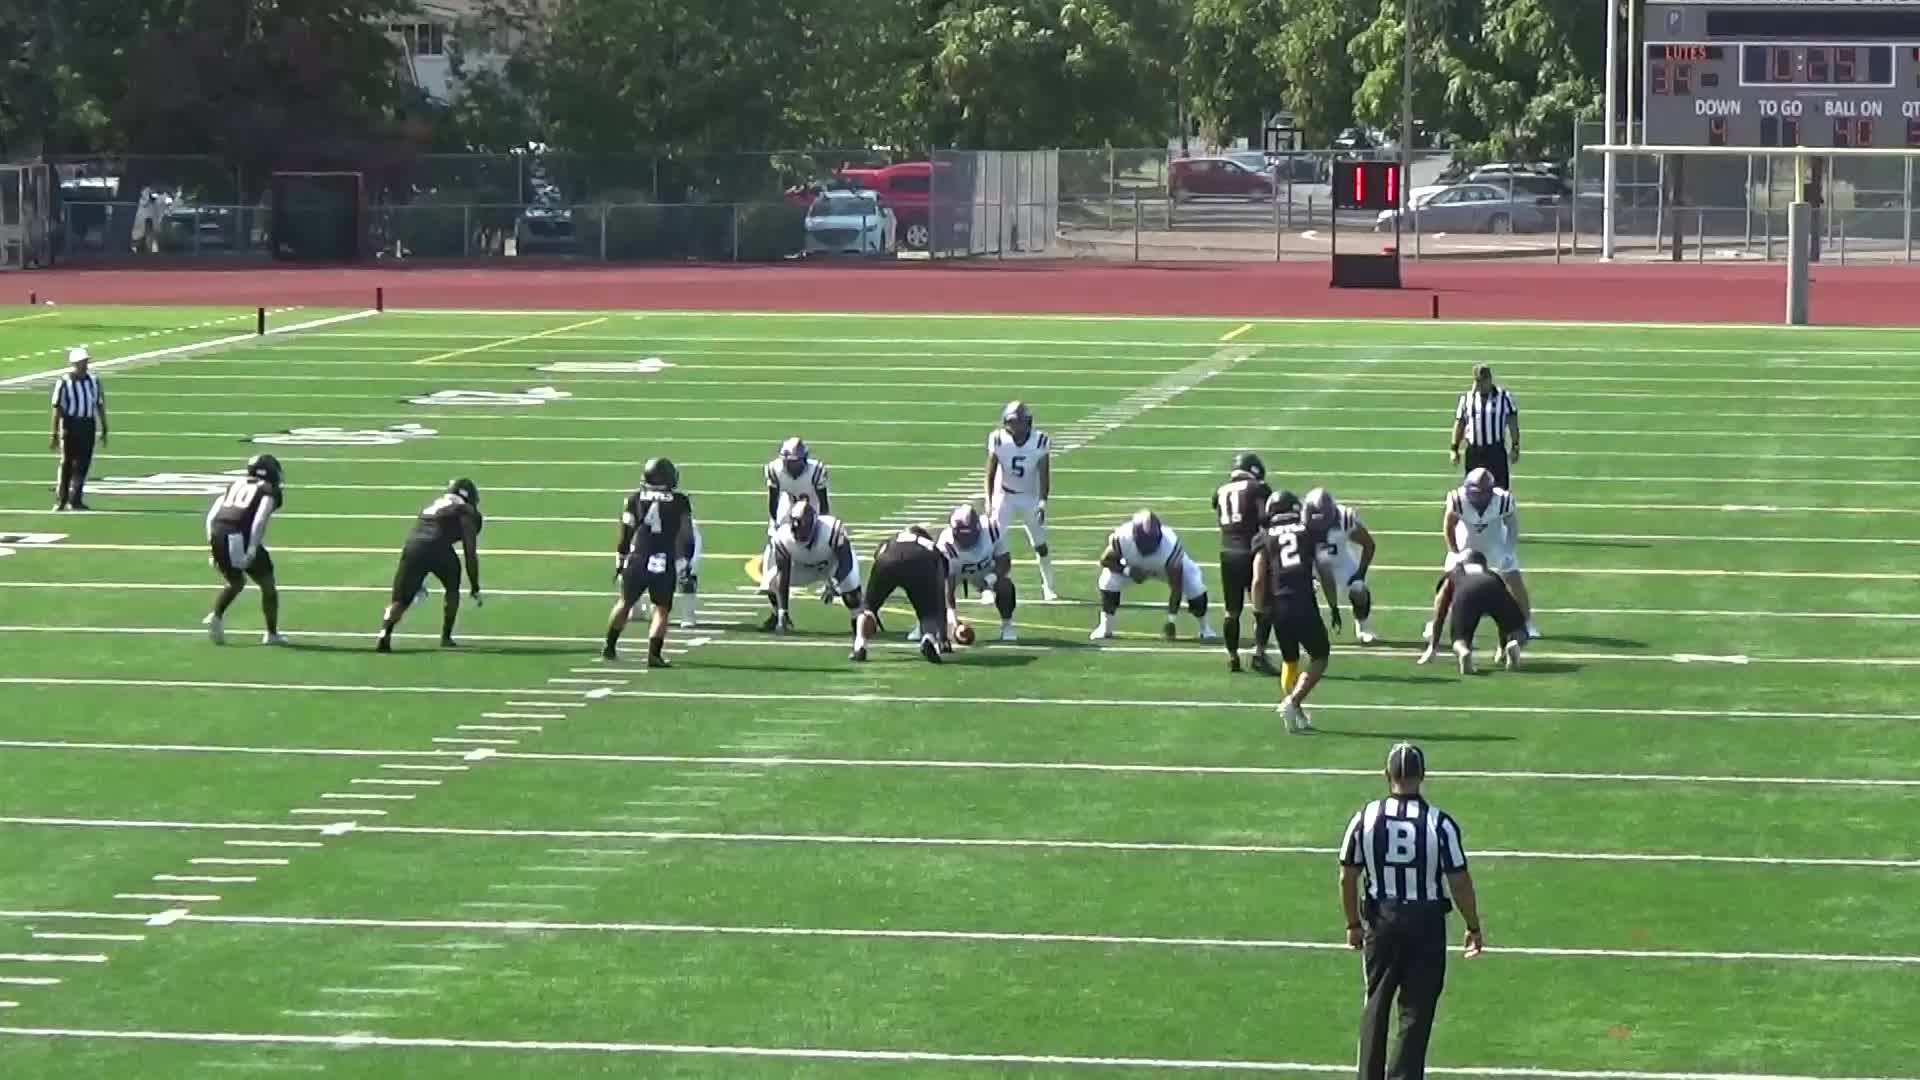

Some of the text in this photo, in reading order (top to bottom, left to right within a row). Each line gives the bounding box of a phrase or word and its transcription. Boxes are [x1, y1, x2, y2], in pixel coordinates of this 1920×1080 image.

[1665, 45, 1707, 60] LUTES
[1696, 100, 1741, 116] DOWN
[1759, 100, 1802, 116] TO GO
[1825, 101, 1882, 117] BALL ON
[1902, 102, 1920, 117] QT
[1356, 166, 1393, 201] 11
[1011, 455, 1027, 478] 5
[224, 481, 259, 509] 10
[1217, 486, 1243, 525] 11
[644, 501, 662, 534] 4
[1278, 532, 1301, 568] 2
[1385, 820, 1418, 864] B
